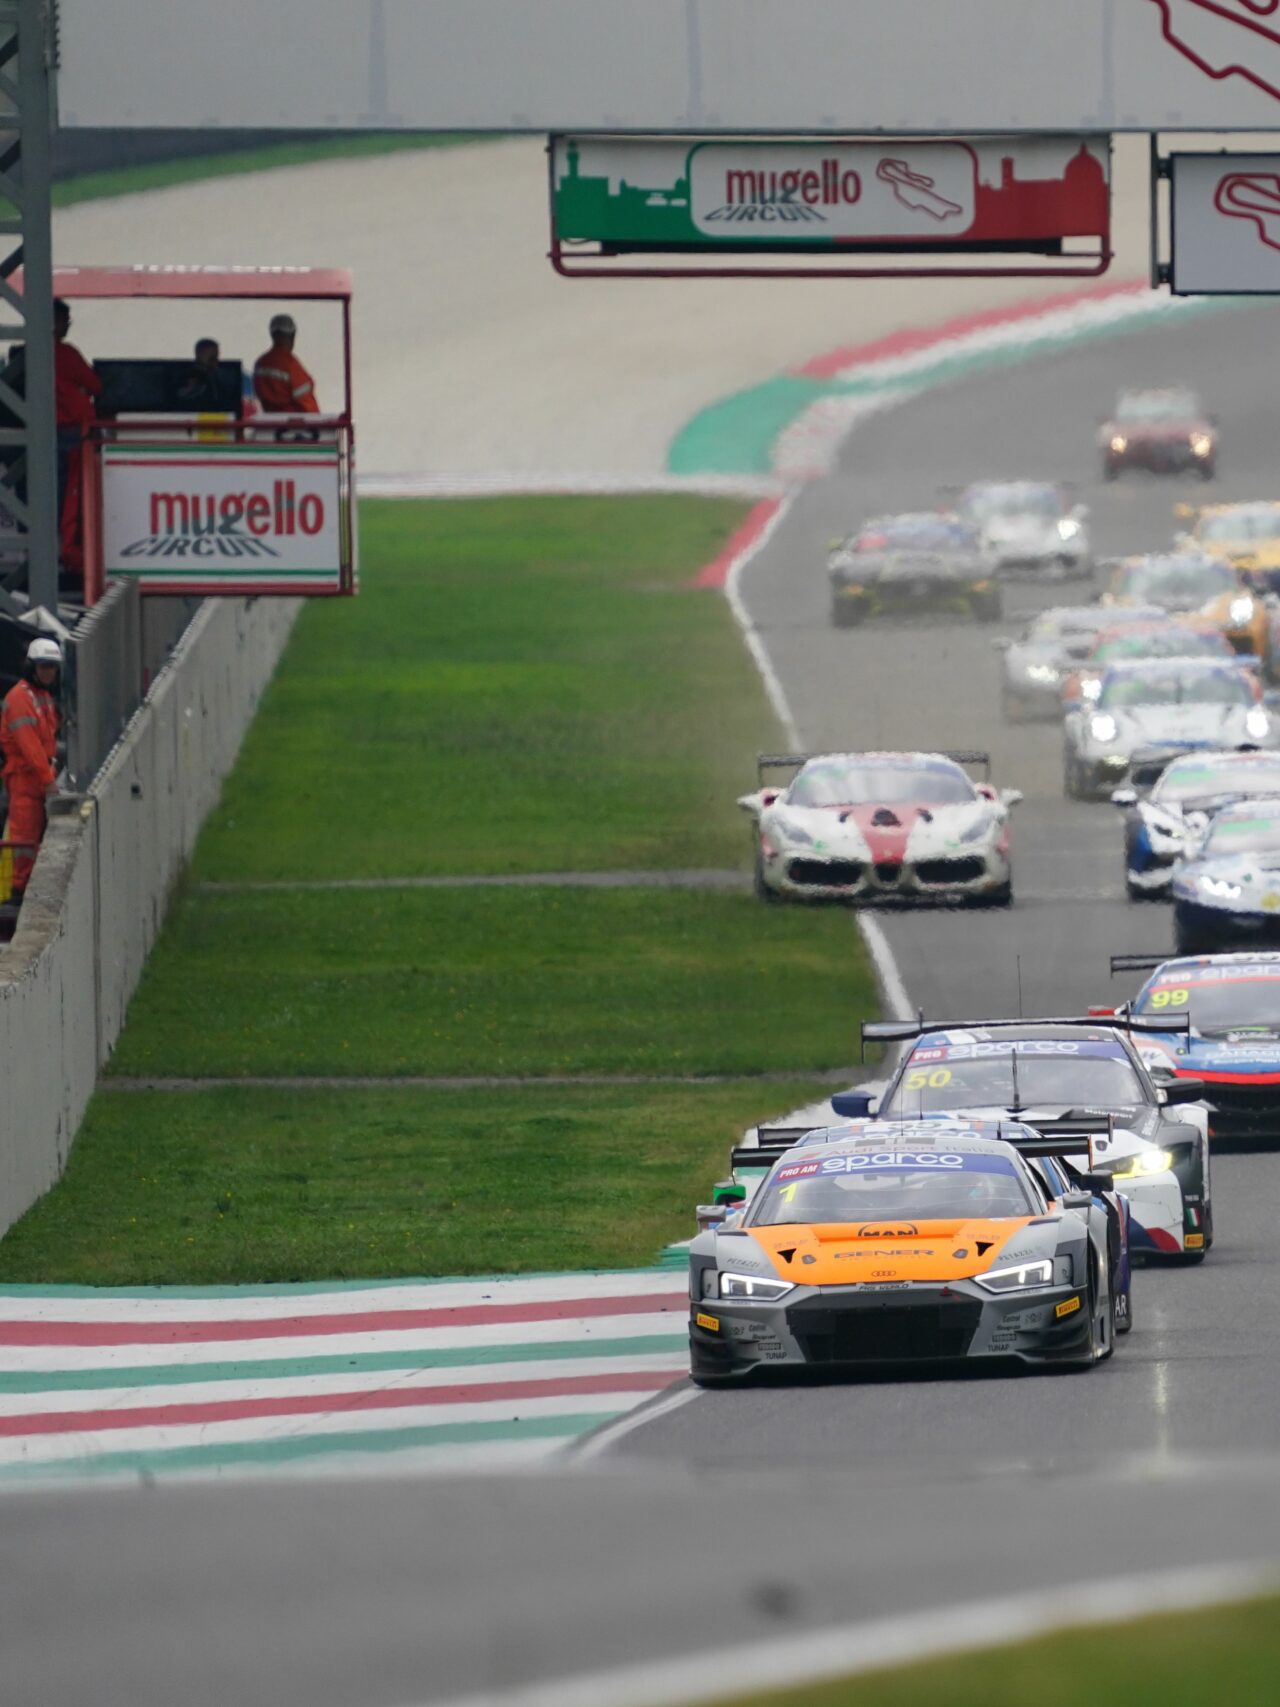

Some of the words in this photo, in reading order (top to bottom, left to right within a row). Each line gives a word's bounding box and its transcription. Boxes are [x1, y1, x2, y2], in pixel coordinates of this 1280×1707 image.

[726, 159, 862, 205] mugello
[704, 204, 828, 222] CIRCUIT
[149, 479, 324, 537] mugello
[119, 537, 281, 557] CIRCUIT
[1152, 988, 1189, 1009] 99
[914, 1050, 942, 1061] PRO
[947, 1040, 1079, 1059] sparco
[904, 1069, 952, 1090] 50
[779, 1166, 798, 1179] PRO
[800, 1164, 818, 1175] AM
[822, 1152, 964, 1172] sparco
[778, 1182, 799, 1203] 1
